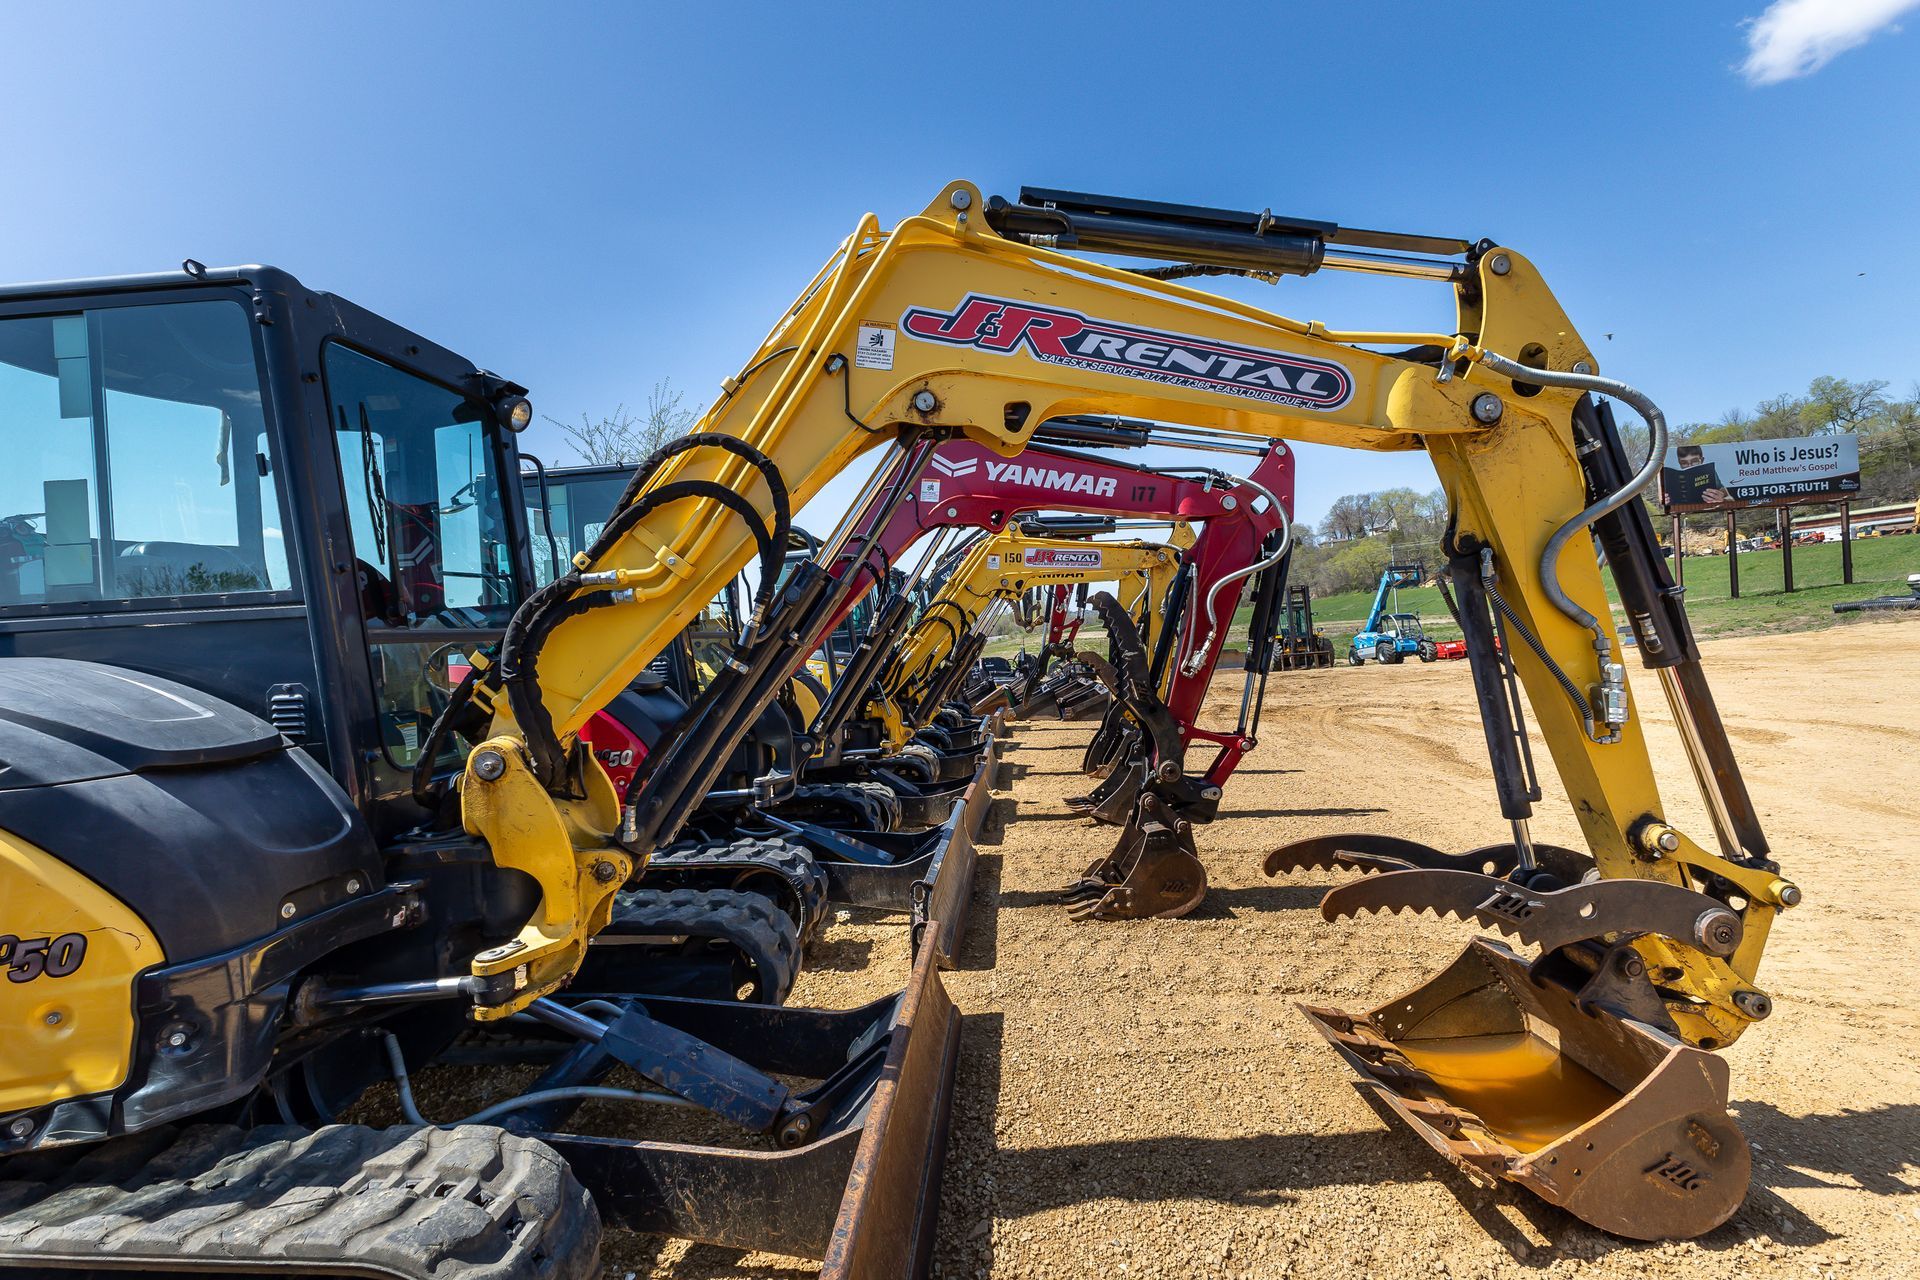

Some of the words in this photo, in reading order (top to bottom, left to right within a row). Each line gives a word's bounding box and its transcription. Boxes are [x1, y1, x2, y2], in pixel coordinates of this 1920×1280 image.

[907, 299, 1084, 358] J&R
[1077, 333, 1329, 396] RENTAL
[1041, 353, 1079, 367] SALES
[1090, 361, 1140, 377] SERVICE
[1143, 371, 1210, 389] 877.747.7368
[1216, 384, 1245, 395] EAST
[1246, 389, 1304, 408] DUBUQUE,
[1735, 449, 1770, 465] Who
[1774, 447, 1786, 462] is
[1790, 443, 1839, 461] Jesus?
[1739, 468, 1760, 477] Read
[1762, 464, 1806, 475] Matthew's
[1808, 462, 1838, 472] Gospel
[985, 461, 1118, 498] YANMAR
[1132, 486, 1156, 502] 177
[1736, 487, 1759, 498] (83)
[1763, 481, 1829, 495] FOR-TRUTH
[1004, 552, 1022, 563] 150
[1054, 554, 1097, 562] RENTAL
